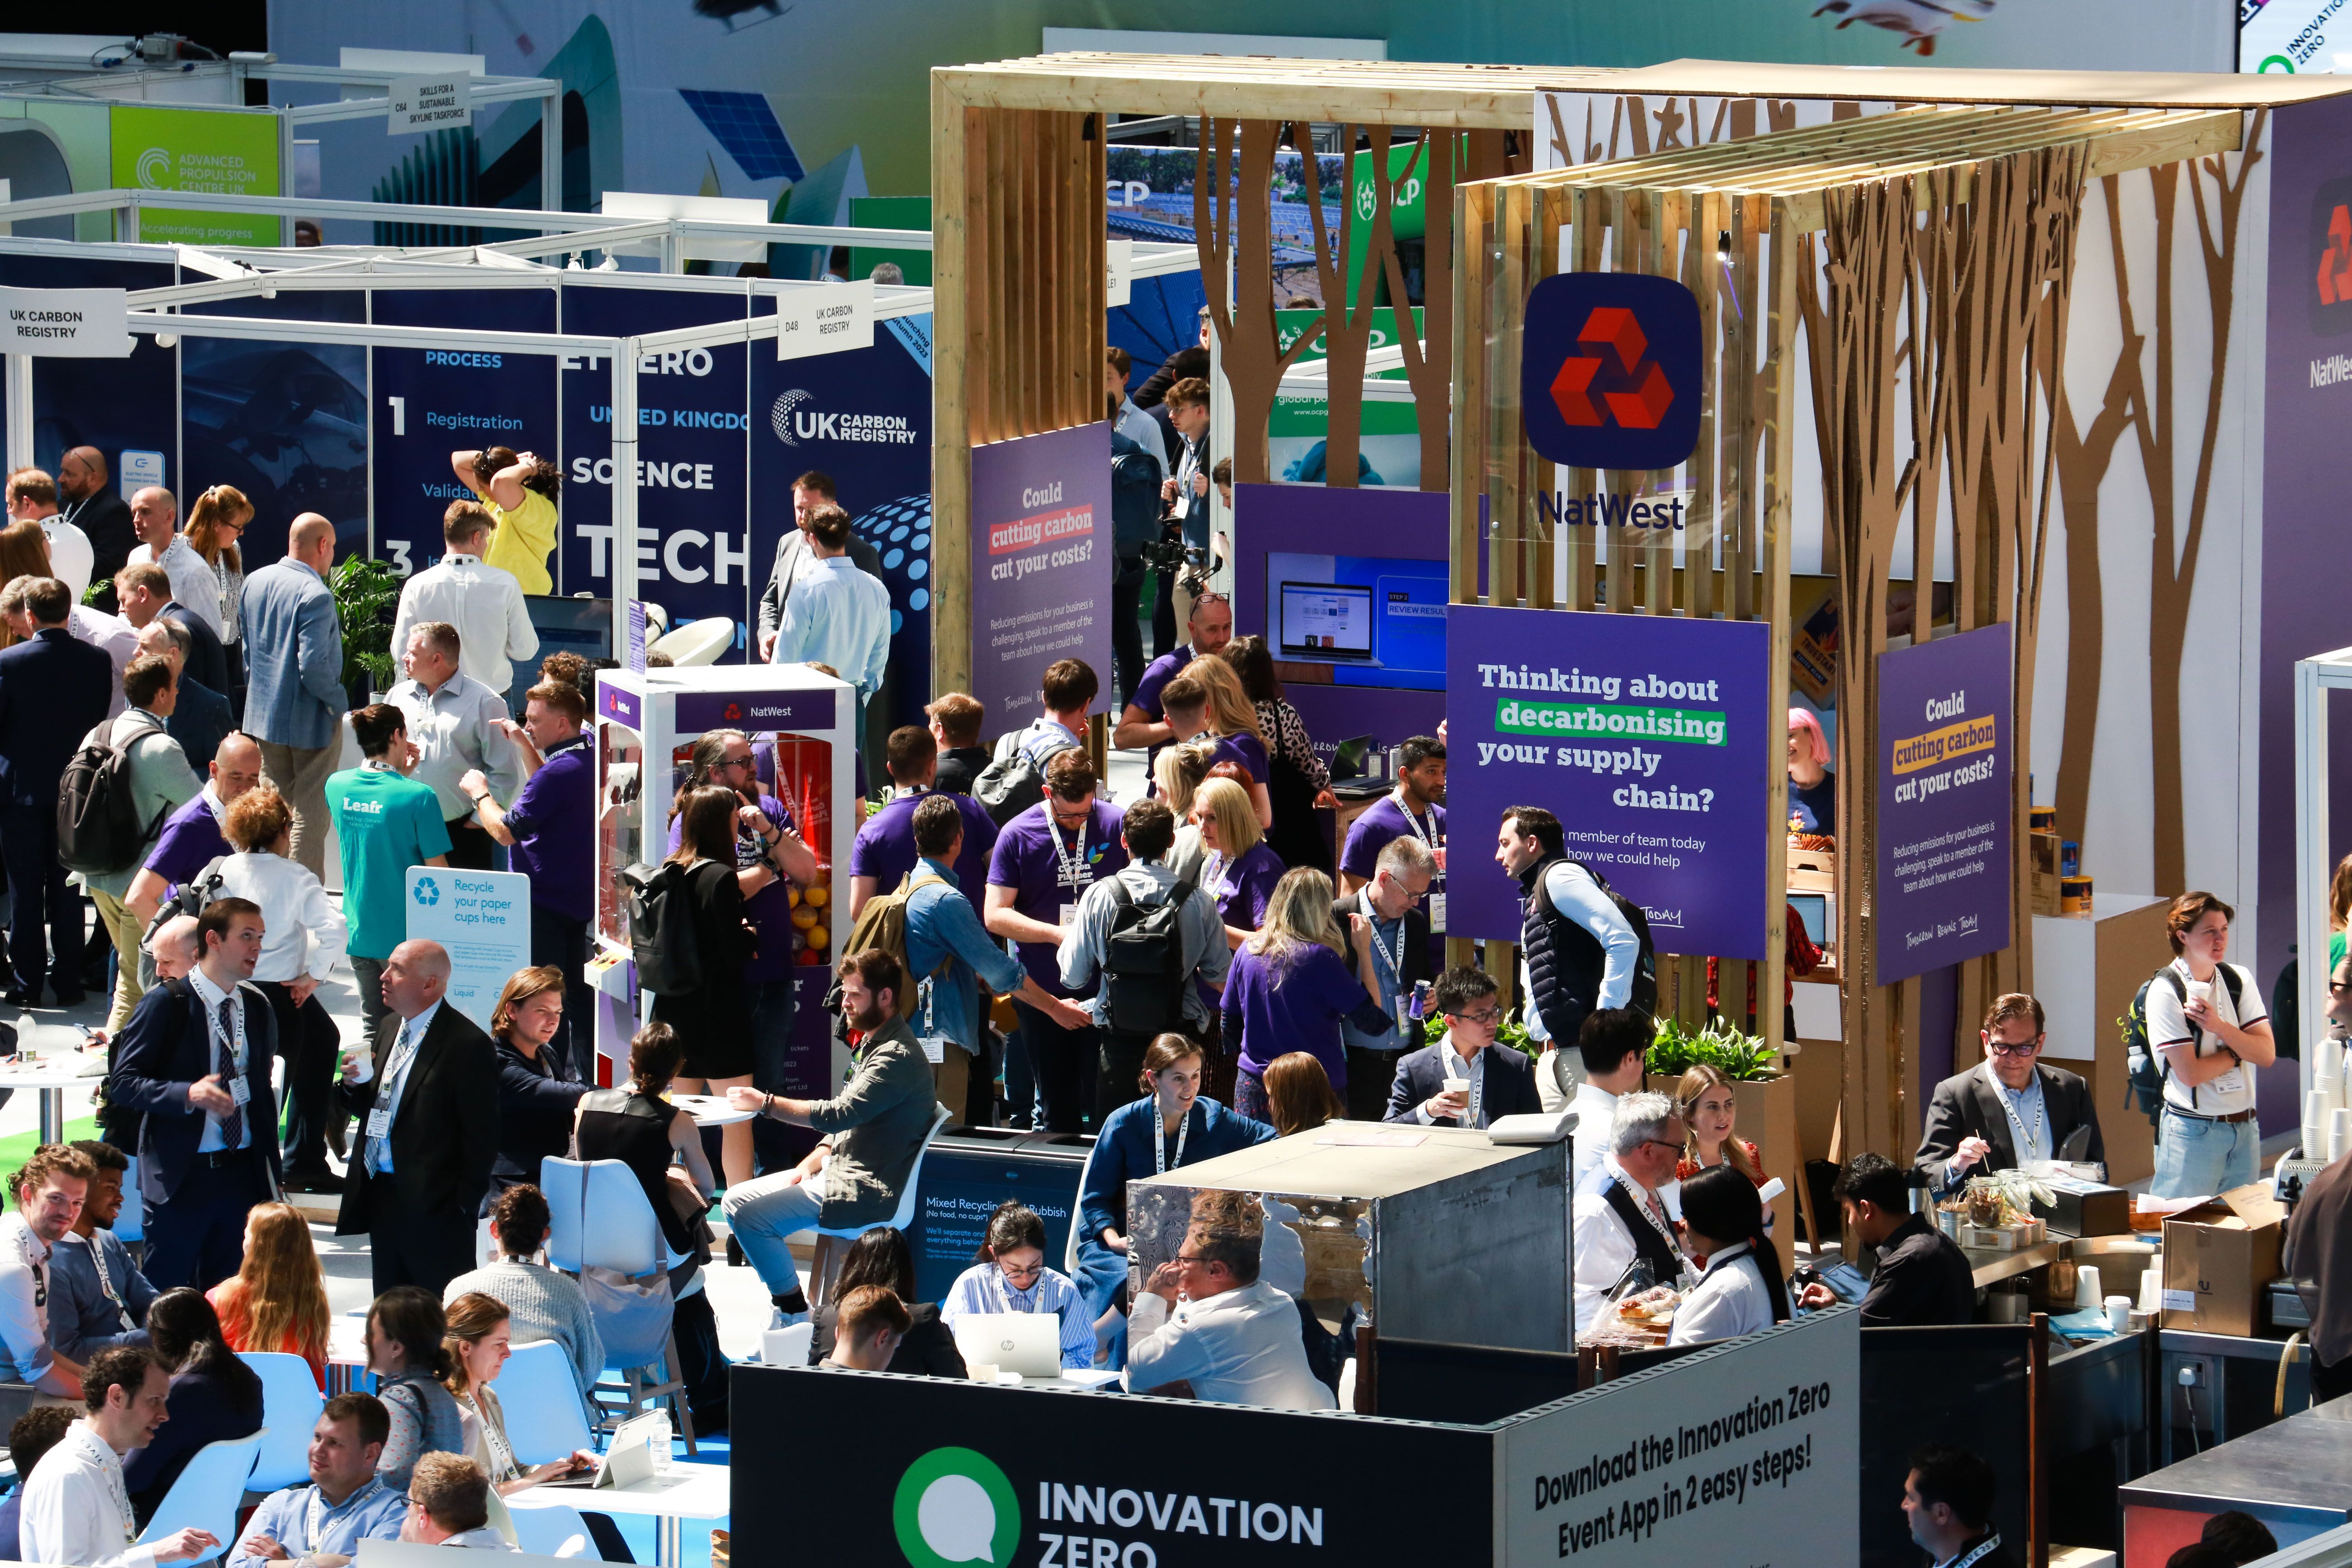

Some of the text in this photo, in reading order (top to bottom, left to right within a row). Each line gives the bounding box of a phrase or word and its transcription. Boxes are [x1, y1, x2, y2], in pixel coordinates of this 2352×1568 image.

[2286, 0, 2348, 54] INNOVATIO
[2295, 35, 2324, 65] ZERO
[420, 86, 437, 96] SKILLS
[438, 85, 449, 94] FOR
[395, 103, 407, 112] C64
[419, 97, 455, 109] SUSTAINABLE
[410, 109, 464, 123] SKYLINE TASKFORCE
[179, 155, 244, 167] ADVANCED
[180, 168, 256, 182] PROPULSION
[180, 181, 245, 195] CENTRE UK
[140, 223, 253, 240] Accelerating progress
[10, 310, 82, 322] UK CARBON
[816, 305, 853, 319] UK CARBON
[17, 326, 76, 337] REGISTRY
[786, 321, 798, 332] D48
[820, 321, 849, 335] REGISTRY
[912, 340, 929, 358] 2023
[426, 351, 502, 368] PROCESS
[389, 397, 404, 436] 1
[427, 412, 523, 430] Registration
[840, 414, 906, 430] CARBON
[796, 412, 839, 440] UK
[840, 427, 916, 444] REGISTRY
[1023, 481, 1062, 508] Could
[1538, 490, 1683, 531] NatWest
[992, 512, 1092, 548] cutting carbon
[386, 540, 413, 579] 3
[576, 524, 747, 586] TECH
[991, 539, 1092, 581] cut your costs?
[991, 598, 1093, 630] Reducing emissions for your business is
[1389, 606, 1419, 614] REVIEW
[992, 632, 1024, 647] challenging,
[1025, 626, 1041, 641] speak
[1042, 625, 1048, 635] to
[1053, 620, 1076, 631] member
[1077, 619, 1082, 627] of
[1083, 615, 1092, 625] the
[1001, 651, 1015, 661] team
[1016, 646, 1032, 657] about
[1034, 644, 1045, 653] how
[1056, 636, 1070, 648] could
[1071, 633, 1083, 646] help
[1478, 663, 1719, 702] Thinking about
[617, 700, 630, 715] NatWest
[750, 706, 792, 718] NatWest
[1926, 690, 1965, 722] Could
[1500, 703, 1725, 744] decarbonising
[1896, 724, 1994, 766] cutting carbon
[1478, 741, 1661, 777] your supply
[1895, 754, 1994, 803] cut your costs?
[343, 797, 383, 814] Leafr
[1612, 783, 1714, 813] chain?
[1569, 830, 1706, 853] member of team today
[1894, 844, 1919, 859] Reducing
[1920, 836, 1945, 851] emissions
[1954, 830, 1967, 844] your
[1968, 824, 1989, 837] business
[1990, 820, 1995, 831] is
[1567, 847, 1680, 869] how we could help
[1895, 839, 1993, 877] challenging, speak to a member of the
[1904, 859, 1984, 893] team about how we could help
[455, 879, 494, 895] Recycle
[455, 897, 512, 912] your paper
[454, 913, 506, 924] cups here
[454, 989, 474, 998] Liquid
[927, 1197, 956, 1208] Mixed
[959, 1199, 999, 1213] Recyclin
[940, 1211, 957, 1219] food,
[927, 1237, 961, 1246] everything
[1003, 1340, 1014, 1351] hp
[1536, 1381, 1829, 1511] Download the Innovation Zero
[1559, 1433, 1811, 1558] Event App in 2 easy steps!
[1039, 1482, 1322, 1546] INNOVATION
[1039, 1532, 1156, 1568] ZERO
